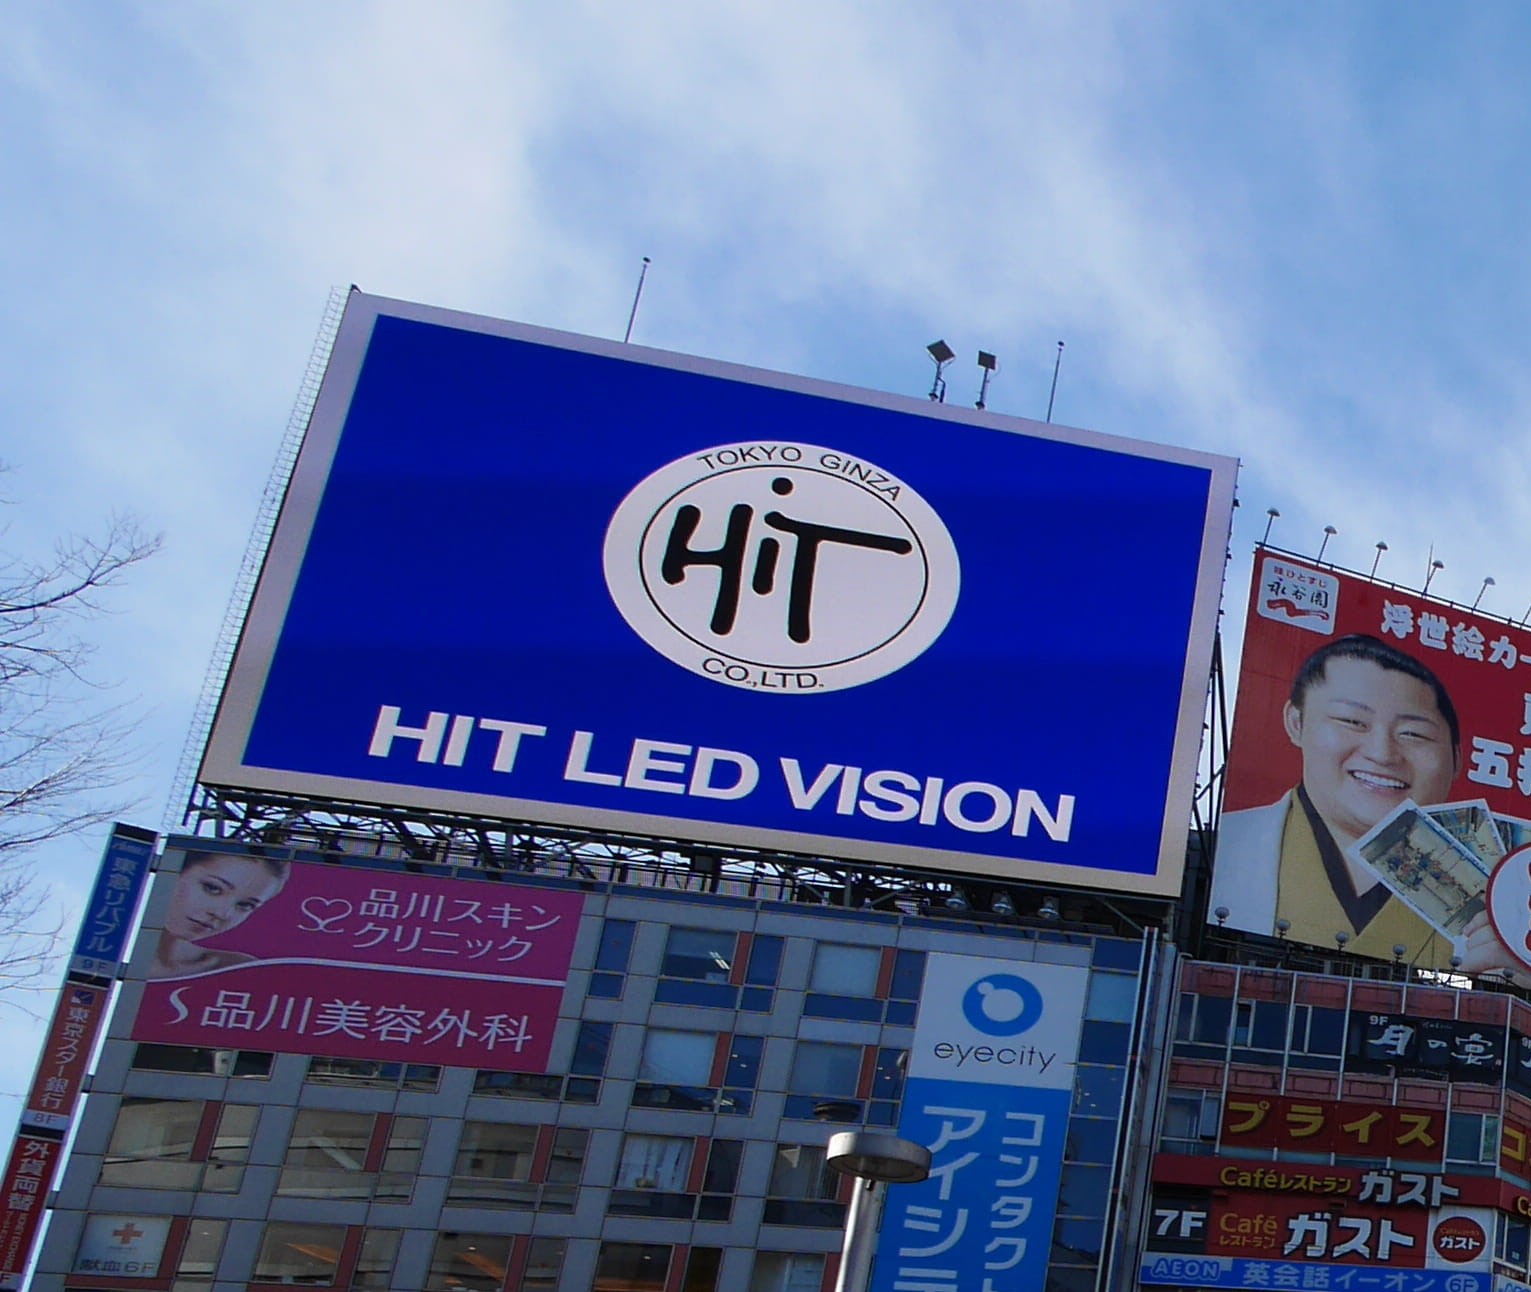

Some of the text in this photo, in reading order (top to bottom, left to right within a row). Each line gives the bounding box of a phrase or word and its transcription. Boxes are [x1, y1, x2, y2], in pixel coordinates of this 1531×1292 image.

[697, 445, 902, 502] TOKYO GINZA
[1266, 576, 1330, 608] 永谷園
[701, 657, 824, 690] CO.,LTD.
[367, 705, 1076, 843] HIT LED VISION
[87, 856, 139, 953] 東急リバブル
[358, 887, 562, 929] 品川スキン
[353, 921, 534, 964] クリニック
[200, 988, 533, 1054] 品川美容外科
[41, 1006, 91, 1109] 東京スター銀行
[932, 1039, 1058, 1074] eyecity
[1226, 1099, 1438, 1149] プライス
[8, 1140, 50, 1212] 外貨両替
[1219, 1164, 1353, 1196] Caféレストラン
[1358, 1169, 1462, 1208] ガスト
[1153, 1207, 1208, 1240] 7F
[1219, 1212, 1278, 1237] Café
[1281, 1211, 1416, 1261] ガスト
[1150, 1256, 1222, 1282] AEON
